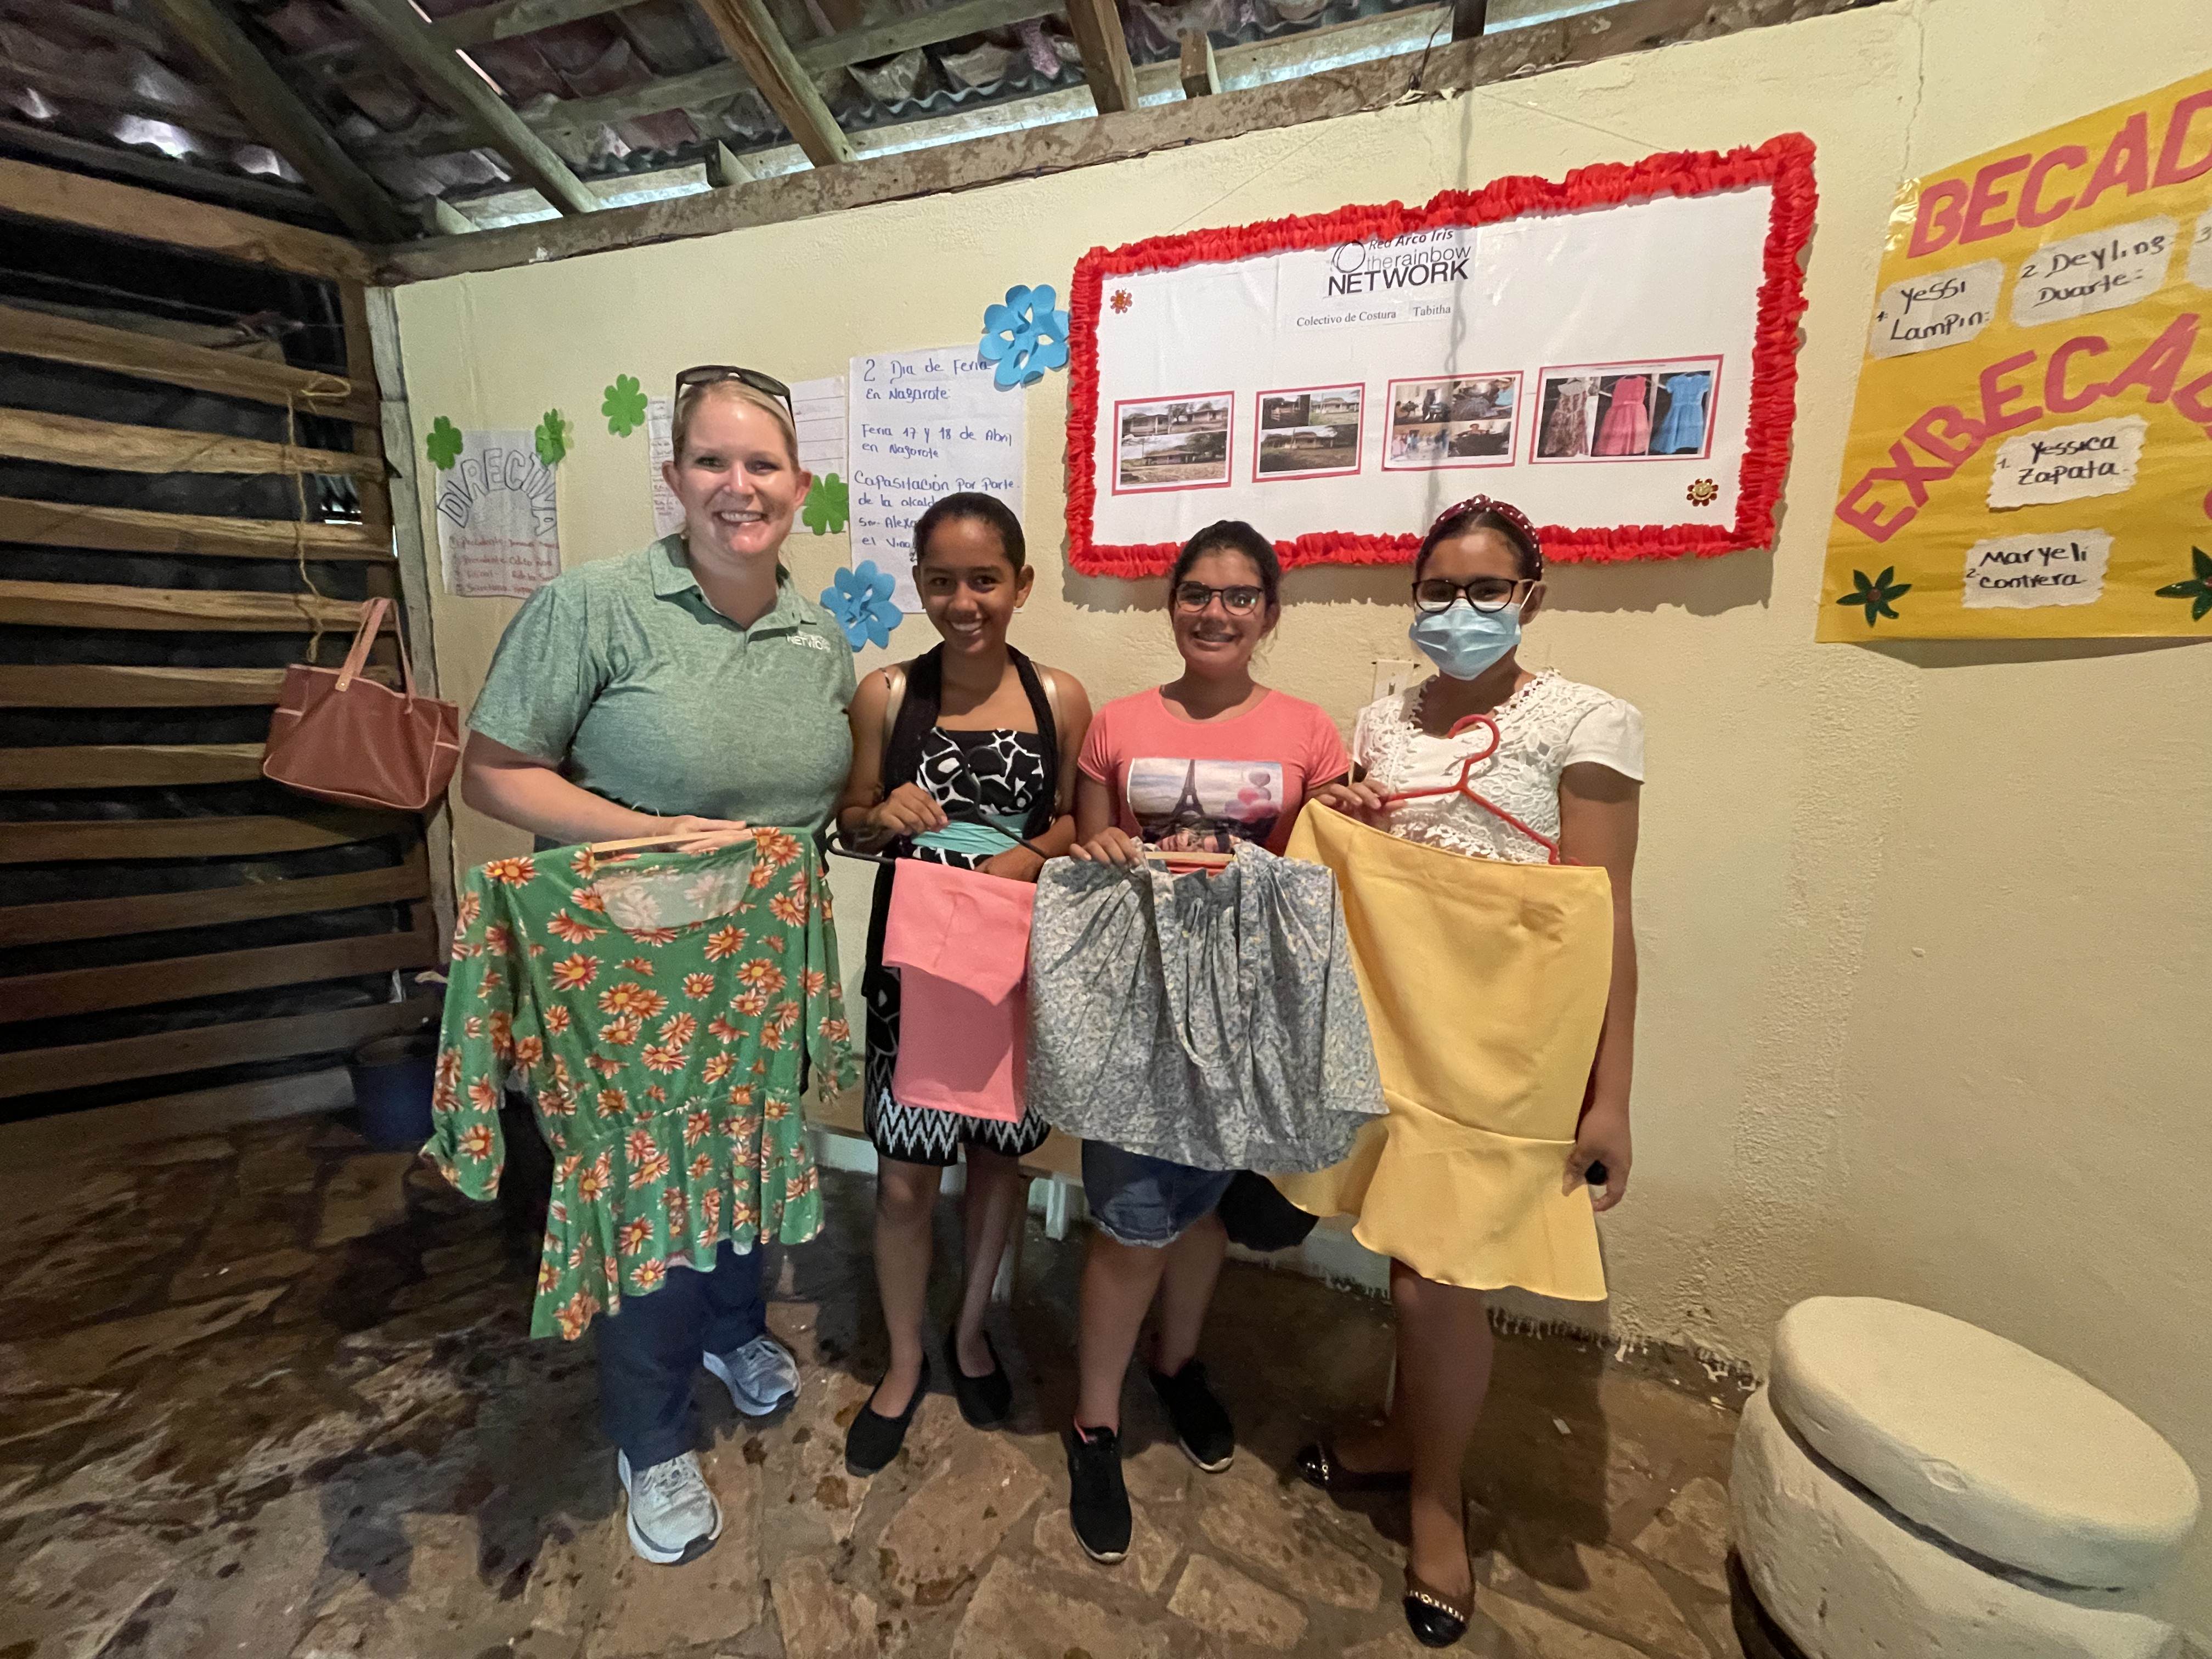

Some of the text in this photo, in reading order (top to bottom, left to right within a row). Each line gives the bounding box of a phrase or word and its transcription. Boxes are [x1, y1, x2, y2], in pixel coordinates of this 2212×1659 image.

[1395, 234, 1427, 247] Arco
[1431, 229, 1454, 242] Iris
[1328, 258, 1470, 296] NETWORK
[1900, 278, 1966, 315] Yessi
[1296, 304, 1451, 327] Colectivo de Costura Tabitha
[864, 359, 876, 382] 2
[925, 357, 944, 373] de
[953, 359, 992, 375] Feria
[866, 388, 881, 400] En
[861, 424, 893, 438] Feria
[902, 427, 917, 439] 17
[938, 427, 951, 439] 18
[960, 425, 977, 440] de
[985, 428, 1012, 447] Abril
[862, 442, 878, 453] en
[2031, 436, 2120, 465] Yessica
[437, 447, 557, 537] DIRECTIVA
[859, 492, 935, 507] de la alcald
[862, 537, 877, 546] el
